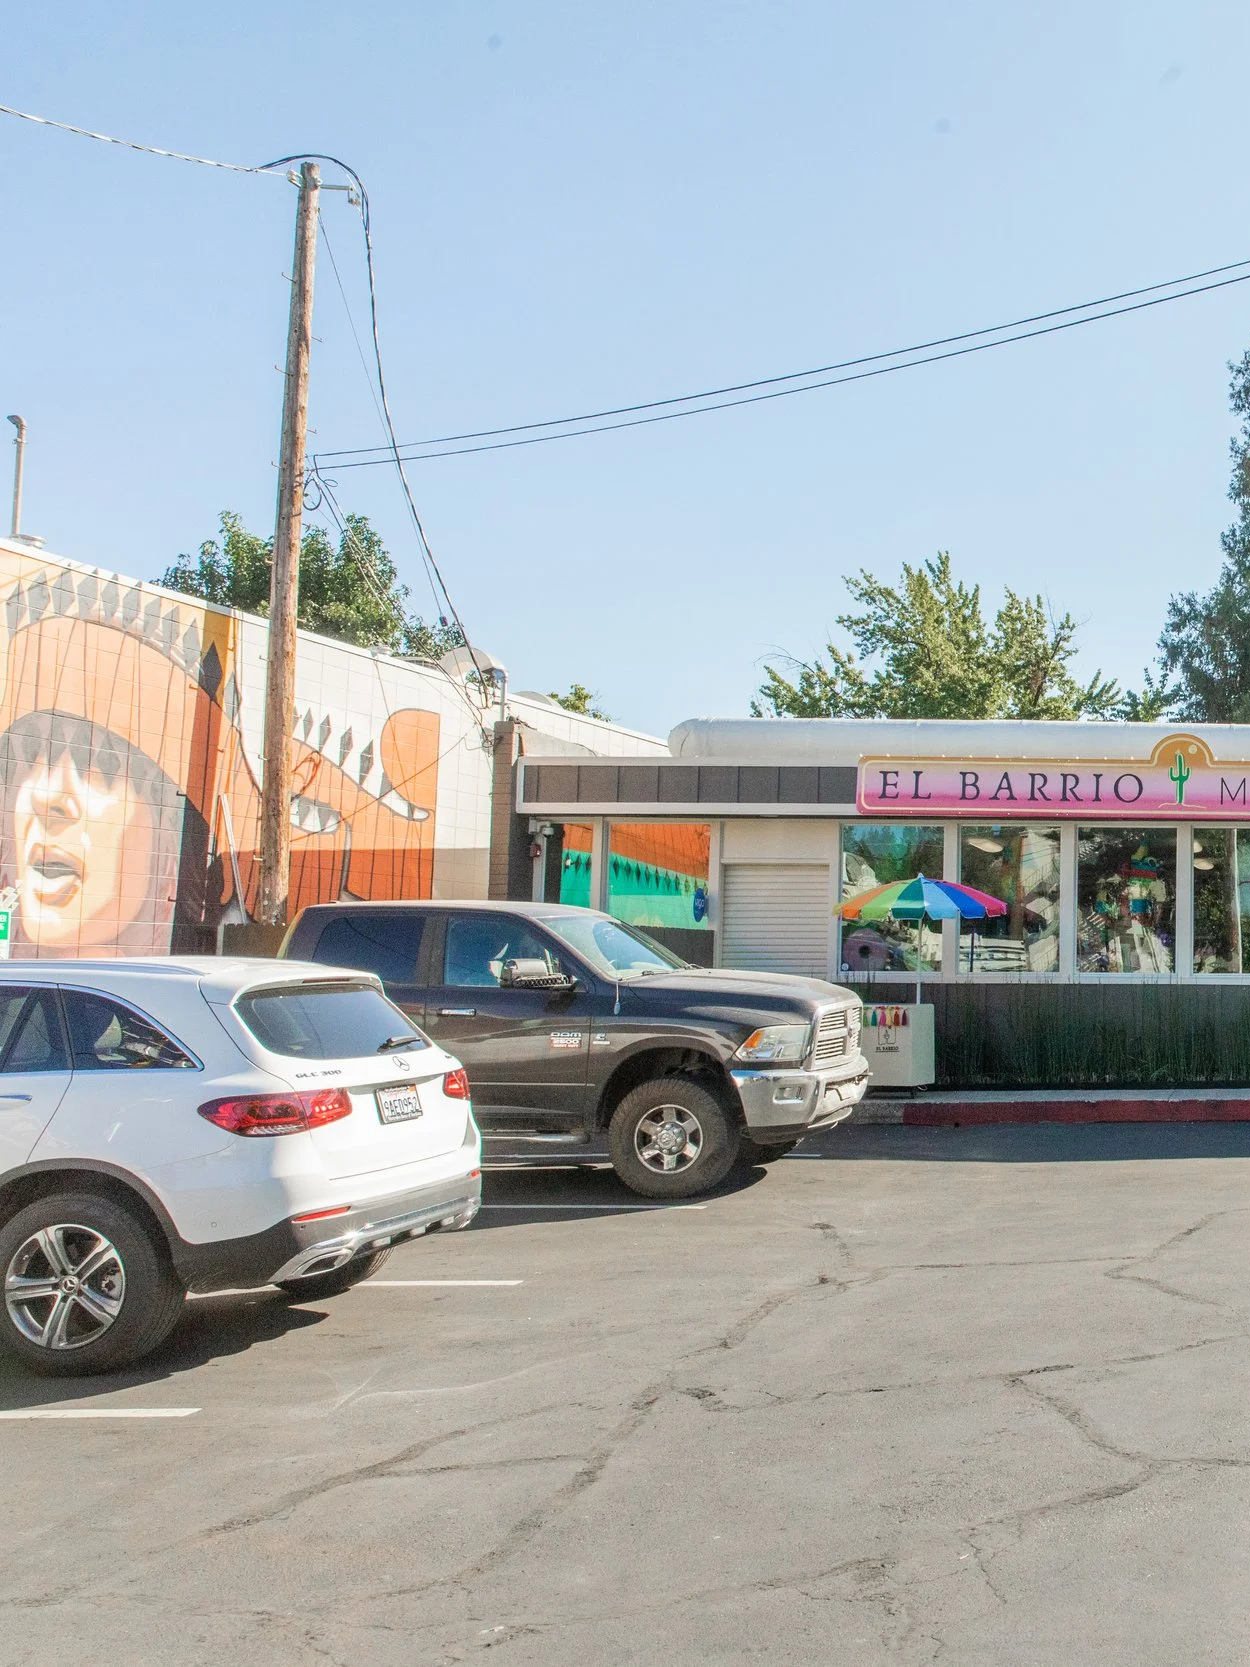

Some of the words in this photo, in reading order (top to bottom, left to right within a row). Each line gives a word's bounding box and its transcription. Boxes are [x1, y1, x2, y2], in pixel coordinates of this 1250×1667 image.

[878, 770, 932, 800] EL
[959, 771, 1144, 804] BARRIO
[295, 1071, 319, 1079] GLC
[320, 1069, 342, 1077] 300
